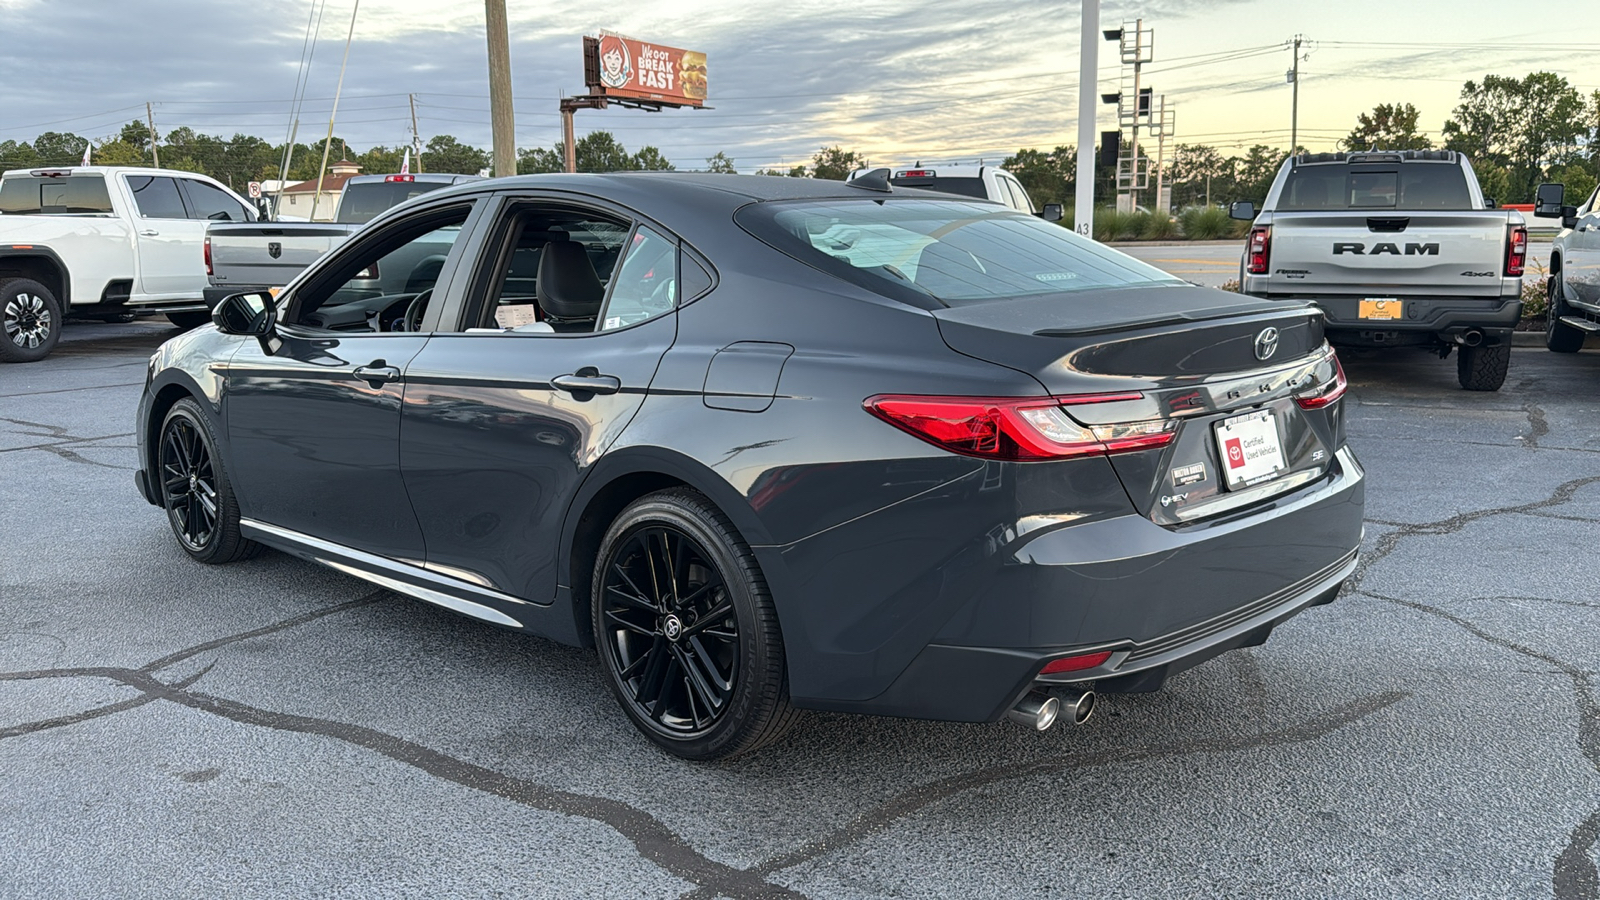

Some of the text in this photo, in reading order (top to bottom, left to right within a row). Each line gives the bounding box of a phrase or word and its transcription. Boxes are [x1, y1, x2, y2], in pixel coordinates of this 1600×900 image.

[641, 44, 653, 60] We
[638, 56, 674, 73] BREAK
[638, 69, 675, 90] FAST
[1076, 222, 1090, 235] A3
[1332, 242, 1440, 256] RAM
[1243, 435, 1265, 449] Certified
[1245, 445, 1277, 460] Used Vehicles
[1312, 450, 1324, 461] SE
[1168, 492, 1189, 503] HEV
[735, 629, 756, 720] TURANZA
